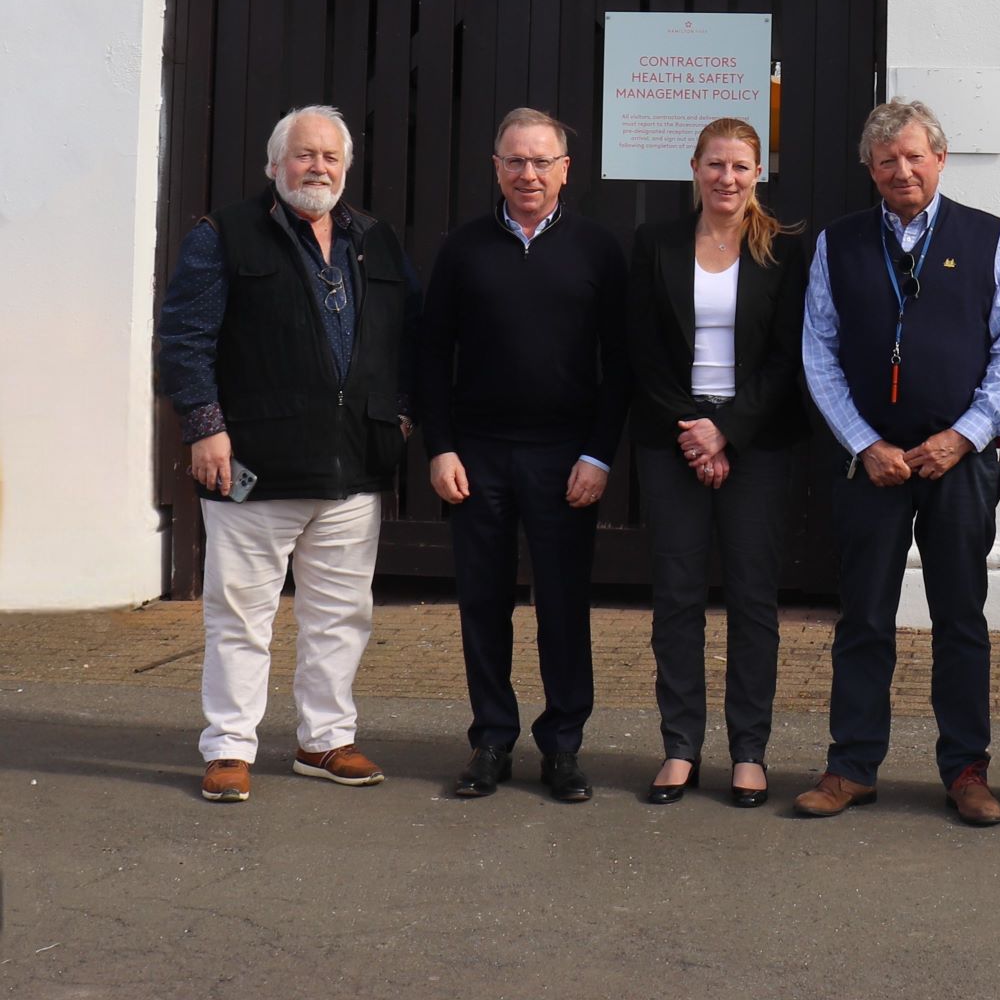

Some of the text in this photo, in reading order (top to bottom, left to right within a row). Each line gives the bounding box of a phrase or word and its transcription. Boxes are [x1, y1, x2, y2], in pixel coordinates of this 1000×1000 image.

[639, 56, 737, 68] CONTRACTORS
[631, 72, 745, 84] HEALTH & SAFETY
[616, 89, 760, 101] MANAGEMENT POLICY
